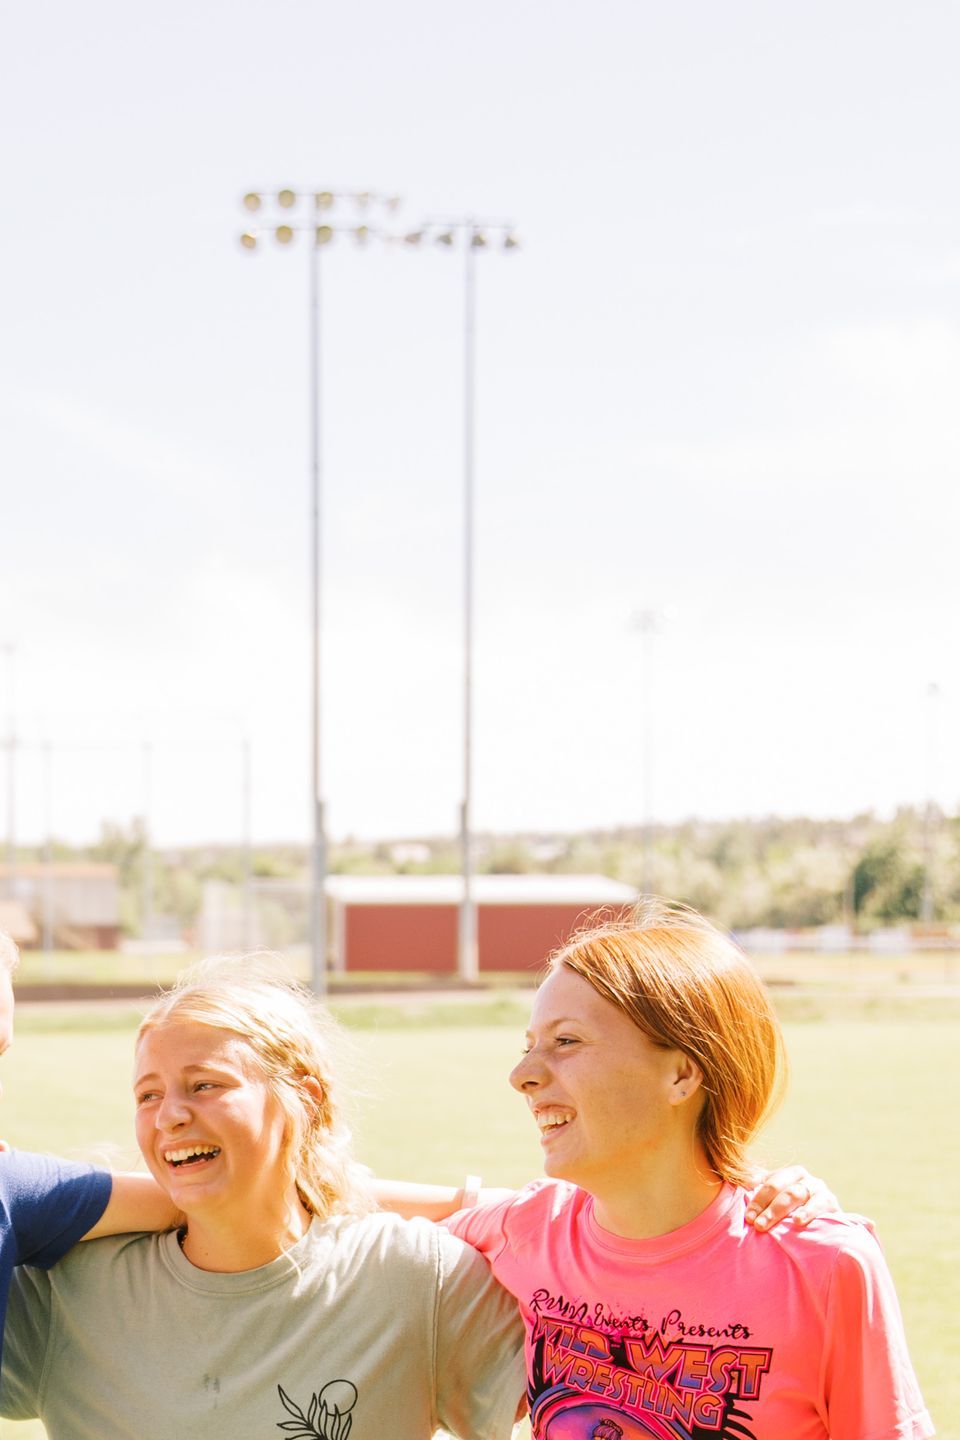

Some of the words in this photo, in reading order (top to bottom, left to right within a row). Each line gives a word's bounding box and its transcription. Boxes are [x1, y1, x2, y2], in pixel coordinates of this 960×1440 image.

[593, 1303, 651, 1331] Events
[661, 1309, 753, 1340] Presents
[542, 1343, 727, 1432] WRESTLING
[620, 1332, 773, 1400] WEST
